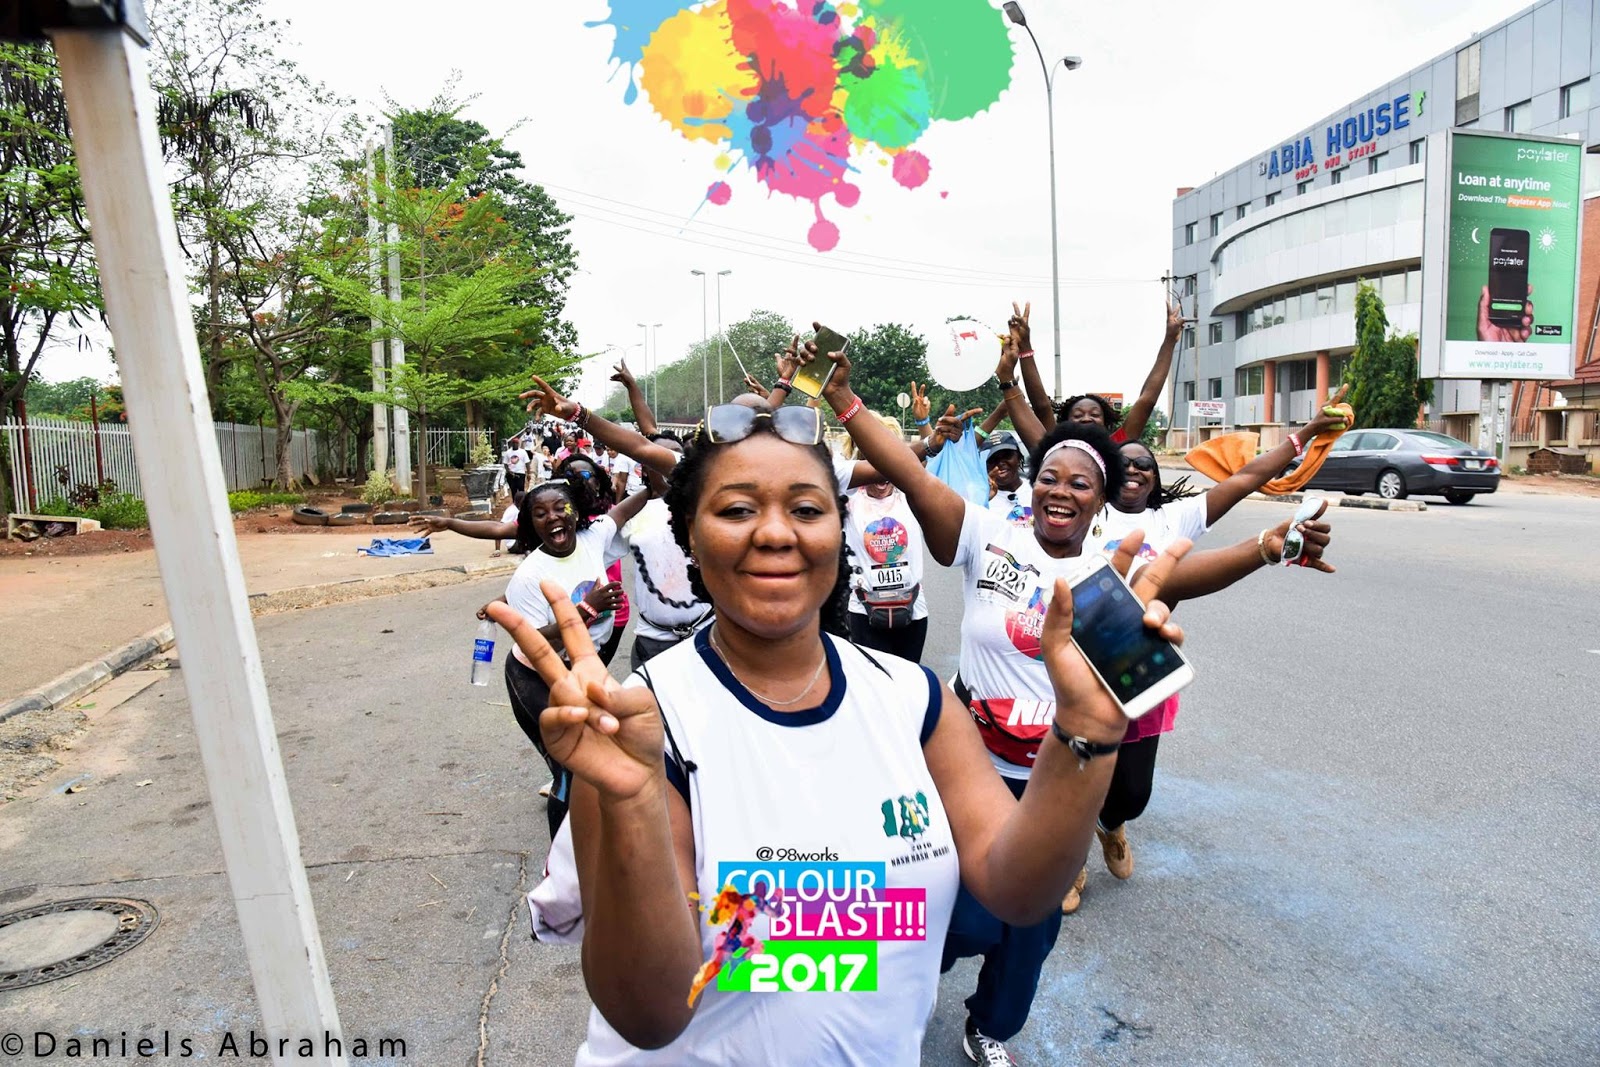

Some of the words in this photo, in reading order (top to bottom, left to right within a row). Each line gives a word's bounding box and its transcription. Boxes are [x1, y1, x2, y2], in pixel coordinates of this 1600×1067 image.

[1267, 136, 1314, 180] ABIA
[1326, 93, 1411, 157] HOUSE
[1295, 164, 1318, 181] GOD'S
[1324, 155, 1341, 170] OWN
[1348, 142, 1377, 162] STATE
[1517, 147, 1569, 163] paylater
[1458, 172, 1487, 187] Loan
[1489, 175, 1502, 188] at
[1503, 177, 1551, 193] anytime
[1458, 193, 1493, 204] Download
[1494, 196, 1507, 204] The
[1508, 197, 1537, 208] Paylater
[1537, 199, 1552, 209] App
[1493, 256, 1525, 267] paylater
[1468, 359, 1544, 371] www.paylater.ng
[869, 538, 896, 547] COLOUR
[877, 569, 903, 585] 0415
[986, 559, 1028, 594] 0326
